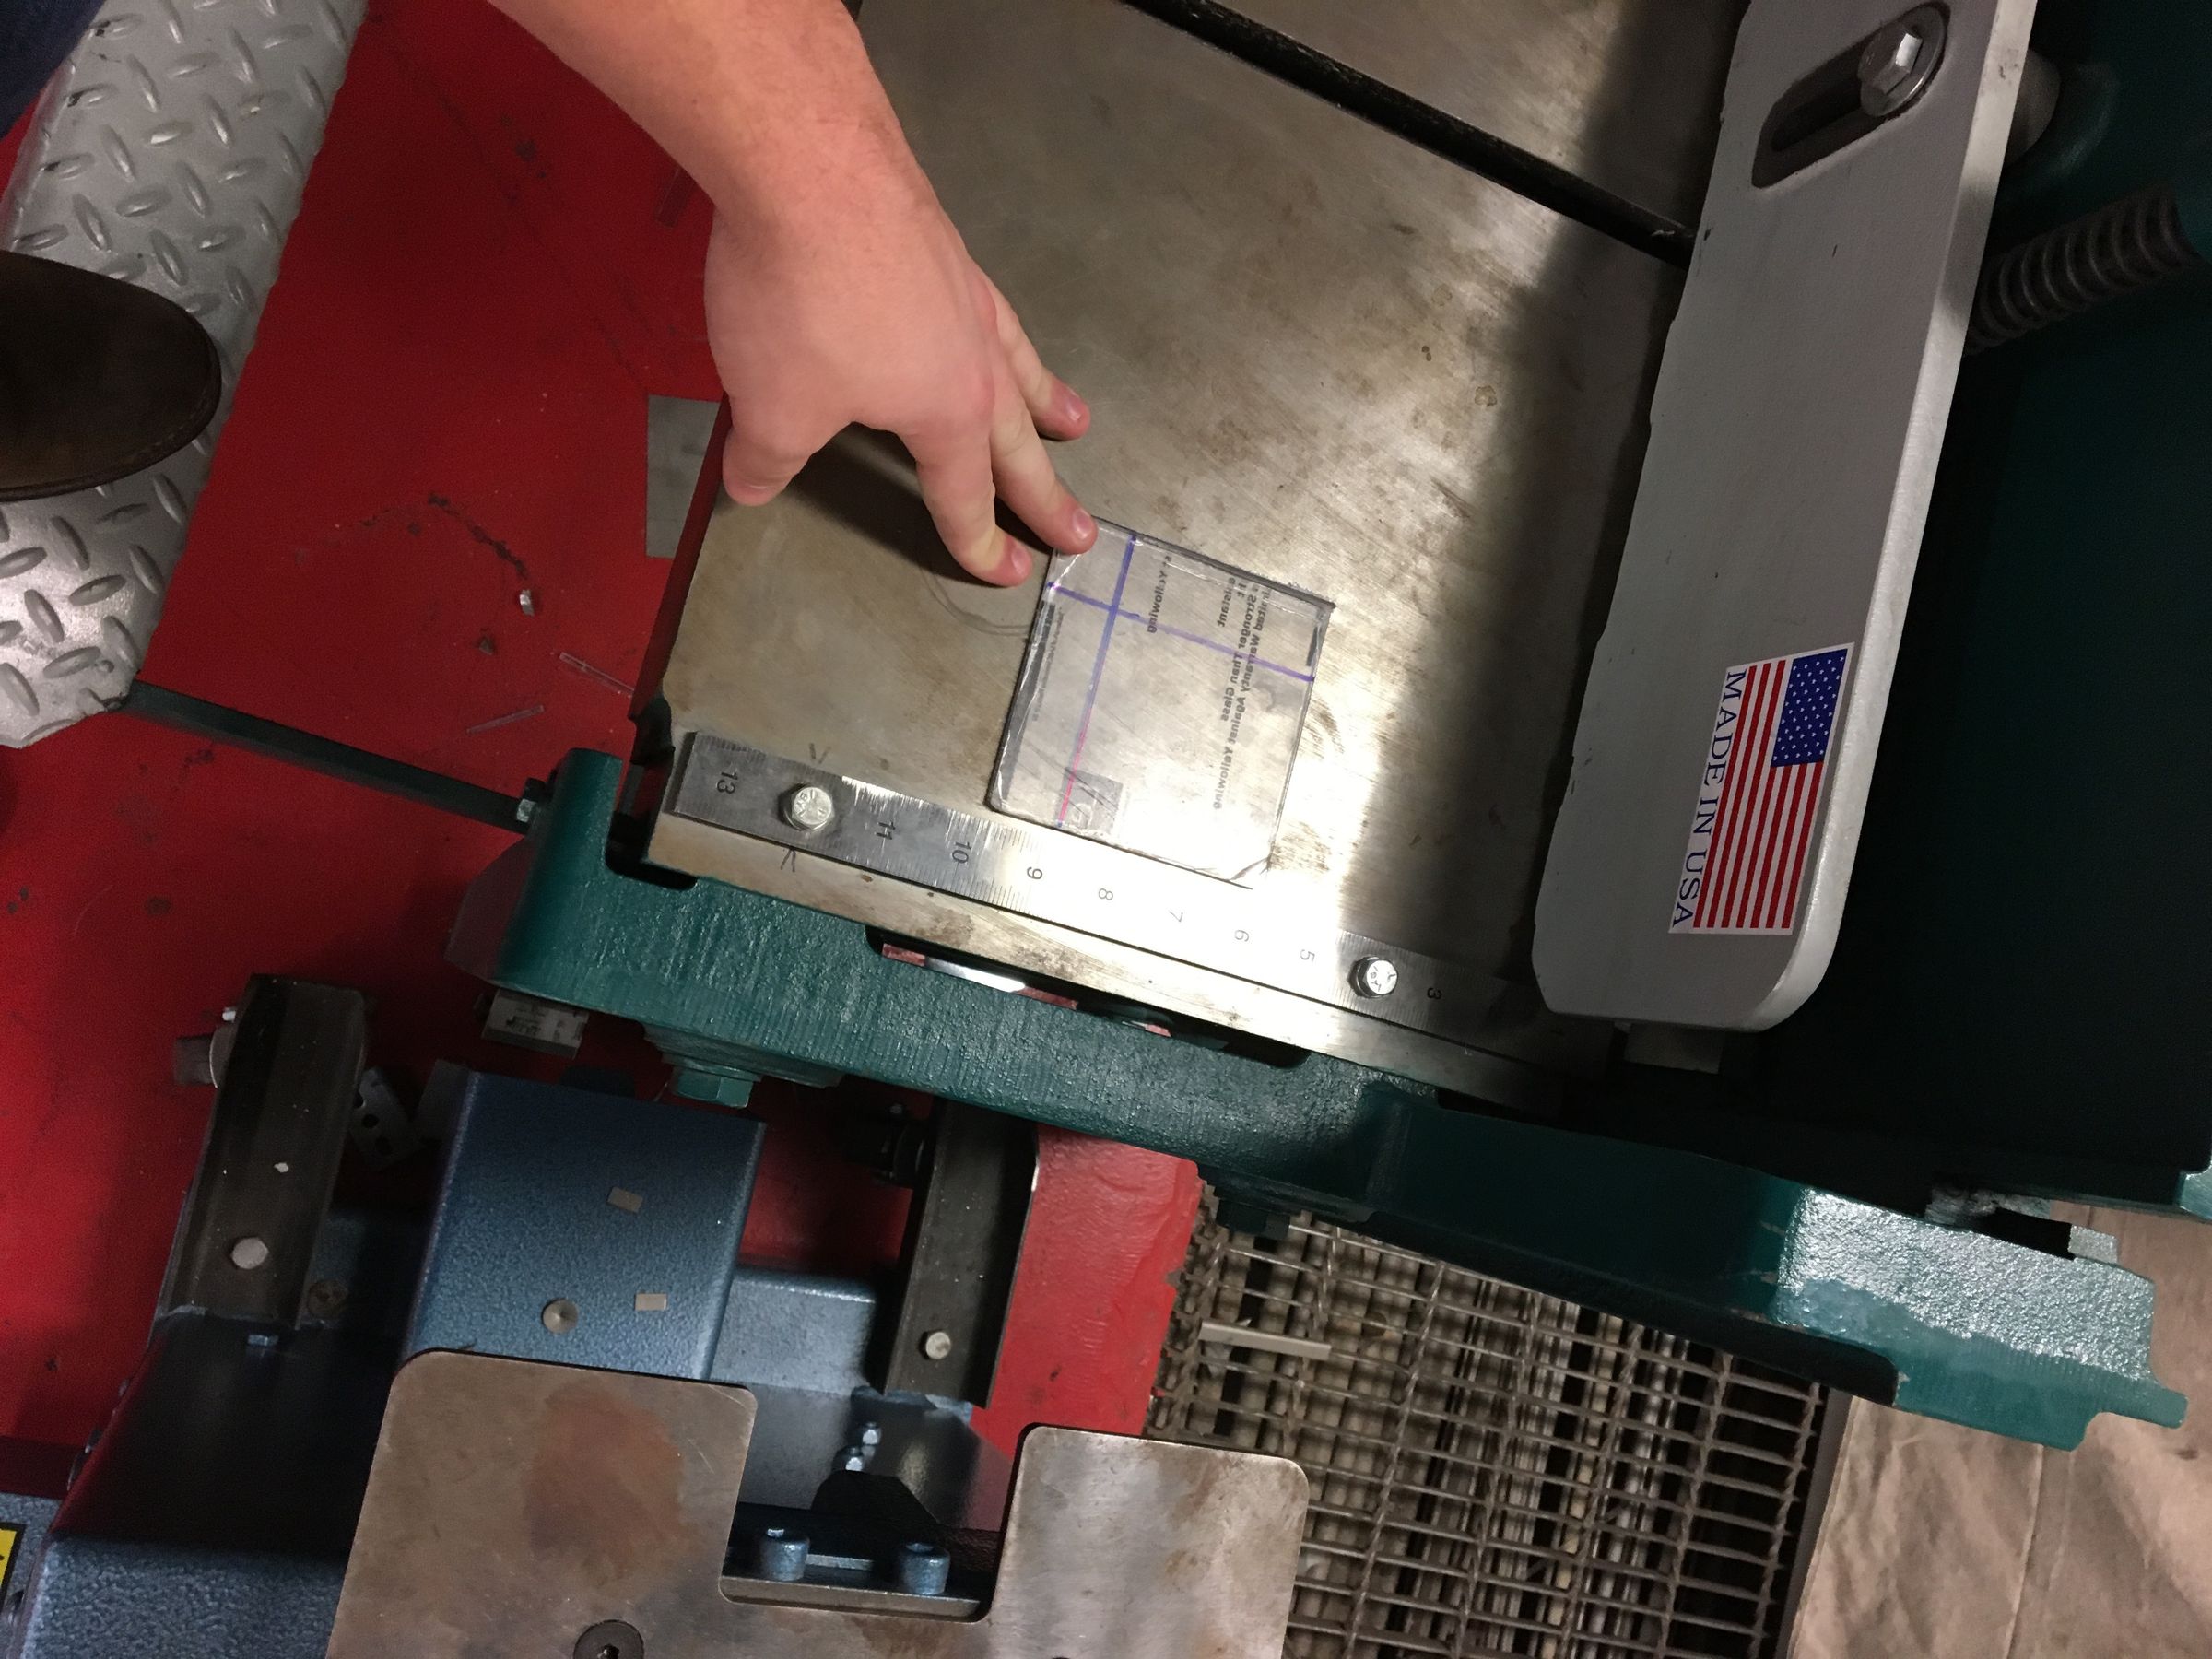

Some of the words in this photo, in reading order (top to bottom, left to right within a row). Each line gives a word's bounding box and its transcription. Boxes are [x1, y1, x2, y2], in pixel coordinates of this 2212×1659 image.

[1703, 669, 1747, 786] MADE
[716, 768, 738, 795] 13
[1692, 796, 1719, 835] IN
[875, 820, 897, 841] 11
[950, 840, 973, 865] 10
[1026, 865, 1044, 881] 9
[1097, 887, 1114, 902] 8
[1673, 850, 1708, 927] USA
[1169, 909, 1184, 924] 7
[1233, 929, 1251, 945] 6
[1300, 947, 1316, 963] 5
[1426, 986, 1442, 1001] 3
